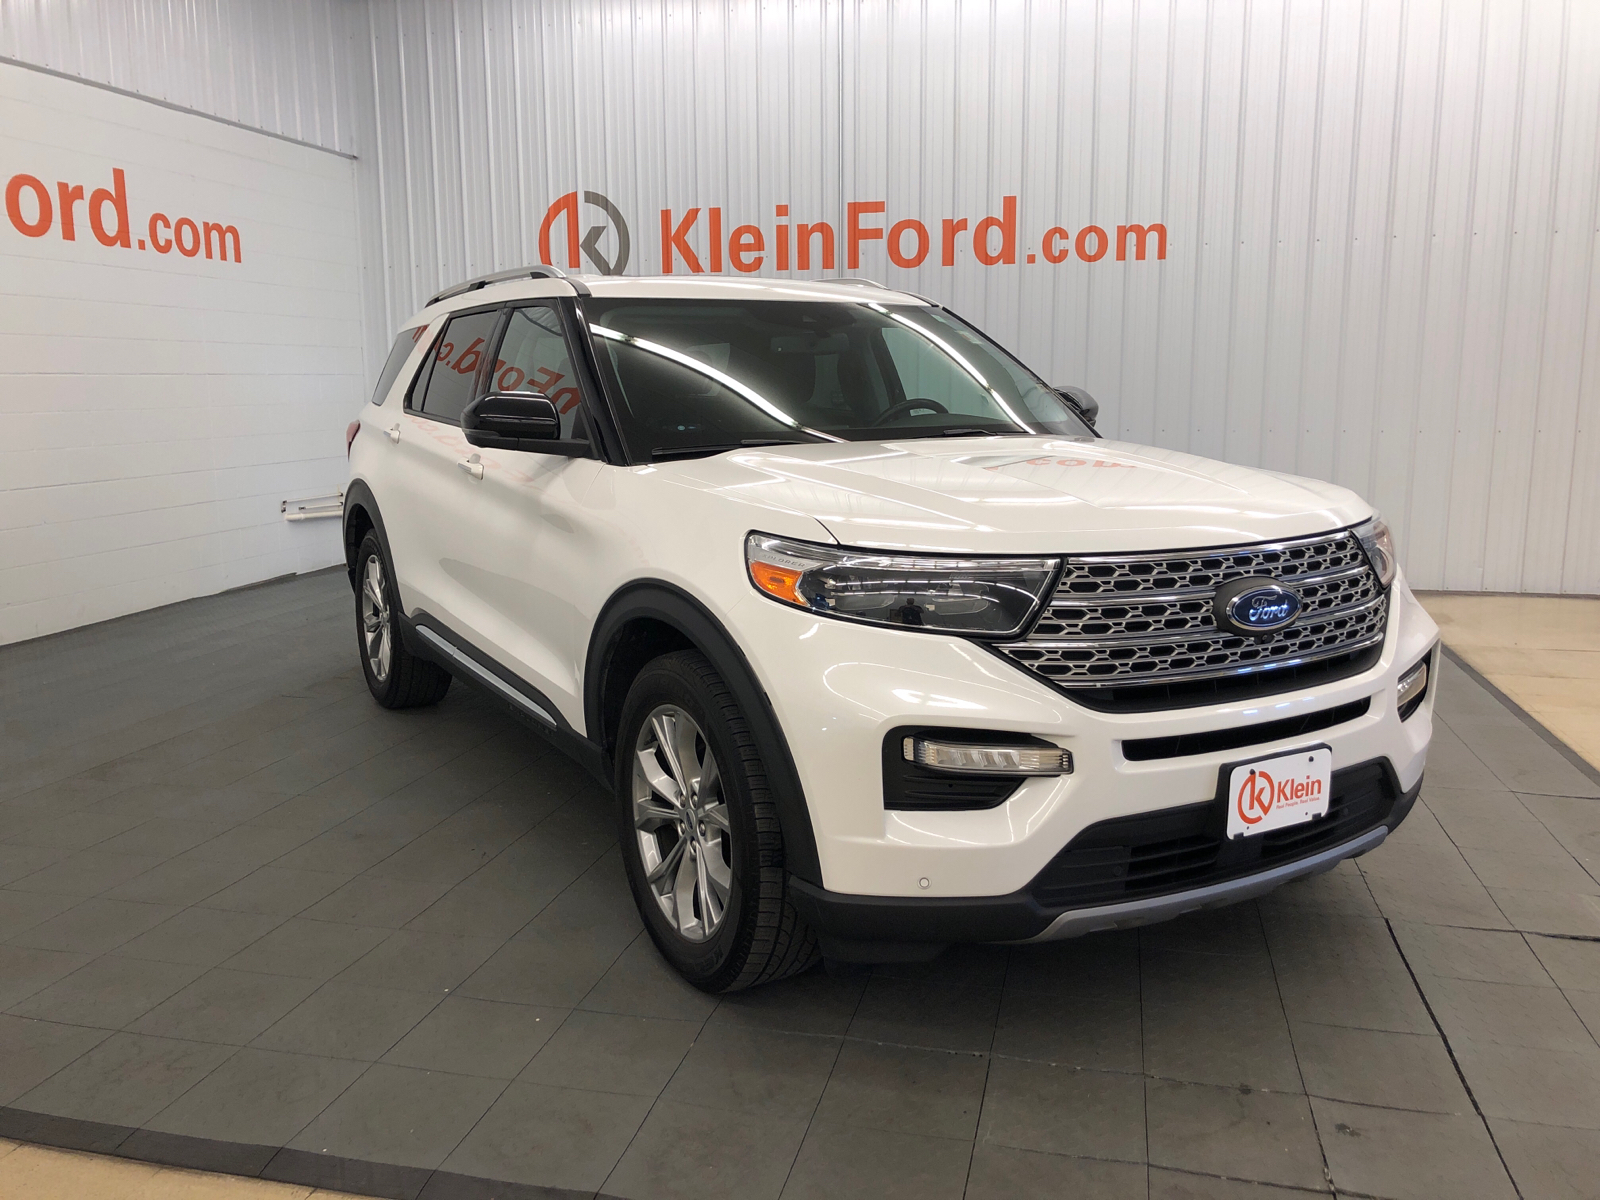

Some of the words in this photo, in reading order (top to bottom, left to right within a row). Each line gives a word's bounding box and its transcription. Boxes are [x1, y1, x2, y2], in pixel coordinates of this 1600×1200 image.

[5, 167, 242, 264] ord.com
[661, 196, 1167, 274] KleinFord.com
[1249, 595, 1289, 622] Ford
[1277, 775, 1322, 803] Klein
